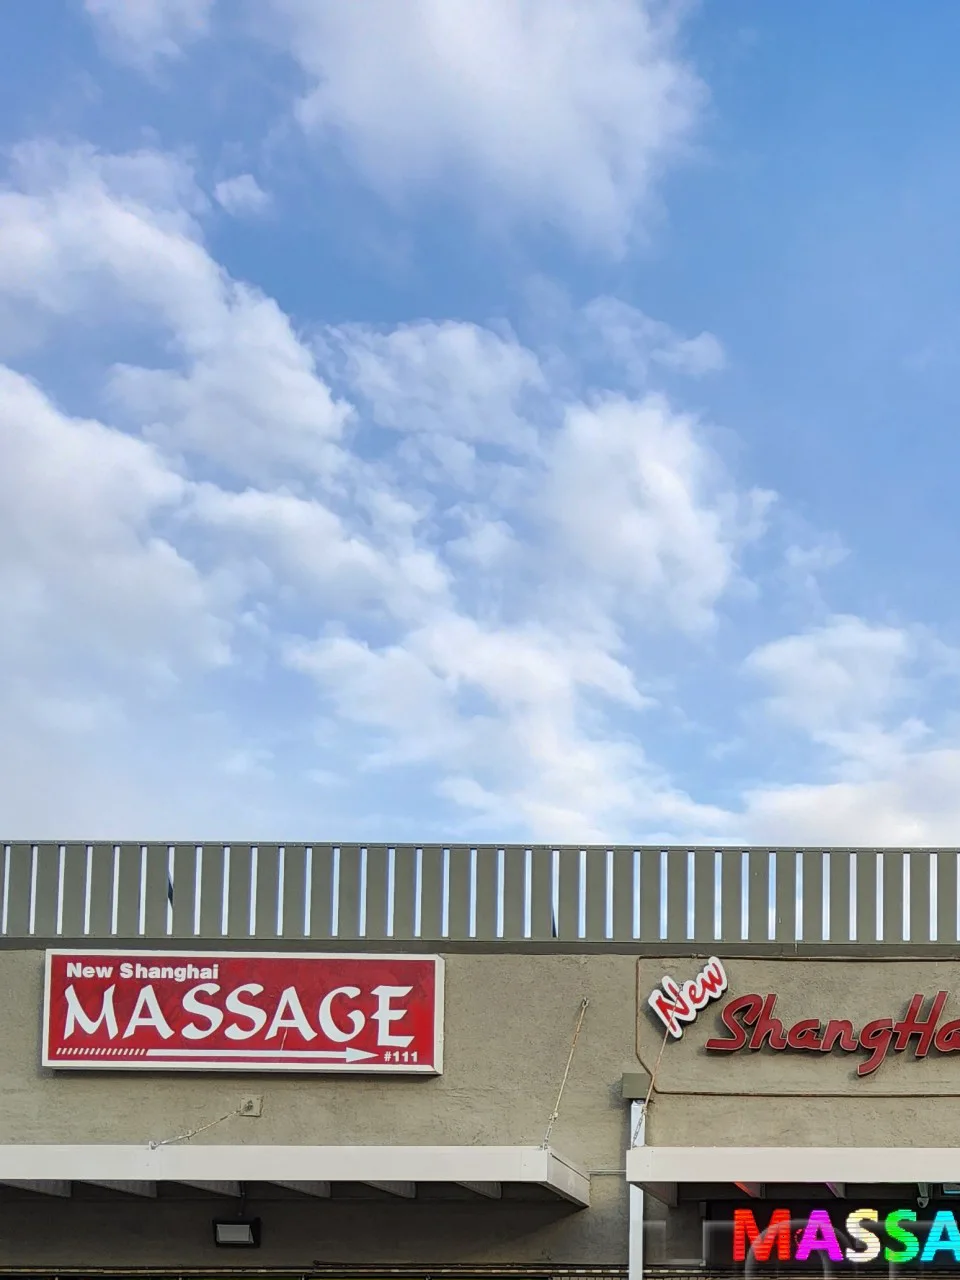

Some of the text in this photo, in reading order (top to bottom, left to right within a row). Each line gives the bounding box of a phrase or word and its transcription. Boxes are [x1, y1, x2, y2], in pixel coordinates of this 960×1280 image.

[66, 963, 219, 982] New Shanghai
[63, 983, 415, 1048] MASSAGE
[650, 957, 728, 1037] New
[384, 1051, 418, 1063] #111
